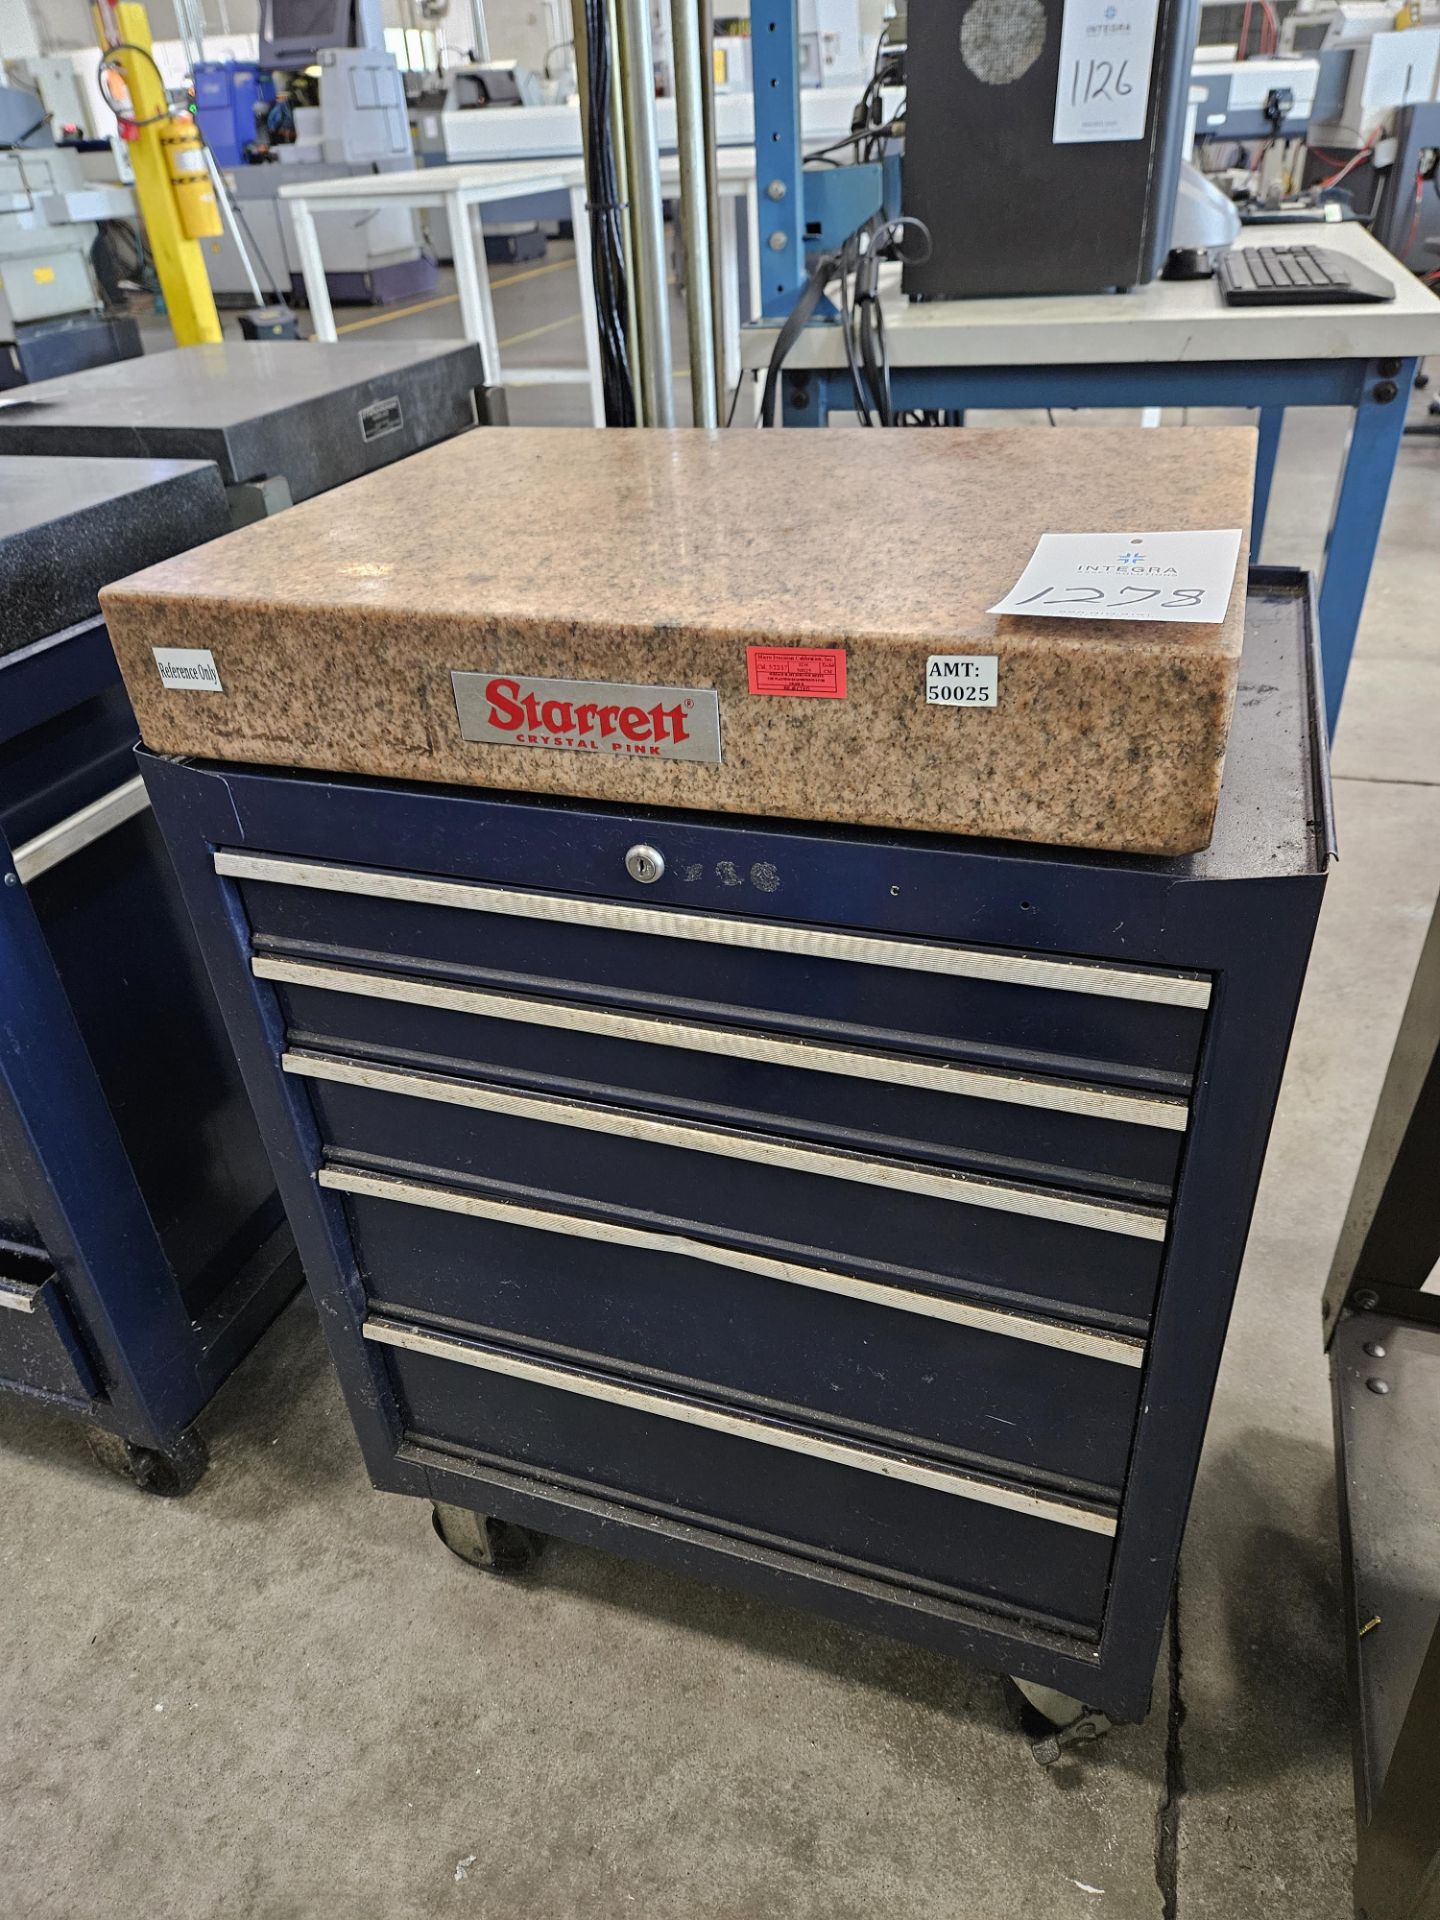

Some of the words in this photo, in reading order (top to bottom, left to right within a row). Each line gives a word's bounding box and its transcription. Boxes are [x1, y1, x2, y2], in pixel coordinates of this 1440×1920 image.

[1071, 59, 1133, 107] 1126
[1077, 565, 1178, 574] INTEGRA
[1015, 586, 1205, 607] 1278
[158, 662, 199, 680] Reference
[197, 664, 217, 685] Only
[929, 662, 979, 677] AMT:
[928, 685, 989, 701] 50025
[516, 734, 599, 749] CRYSTAL
[612, 743, 661, 755] PINK
